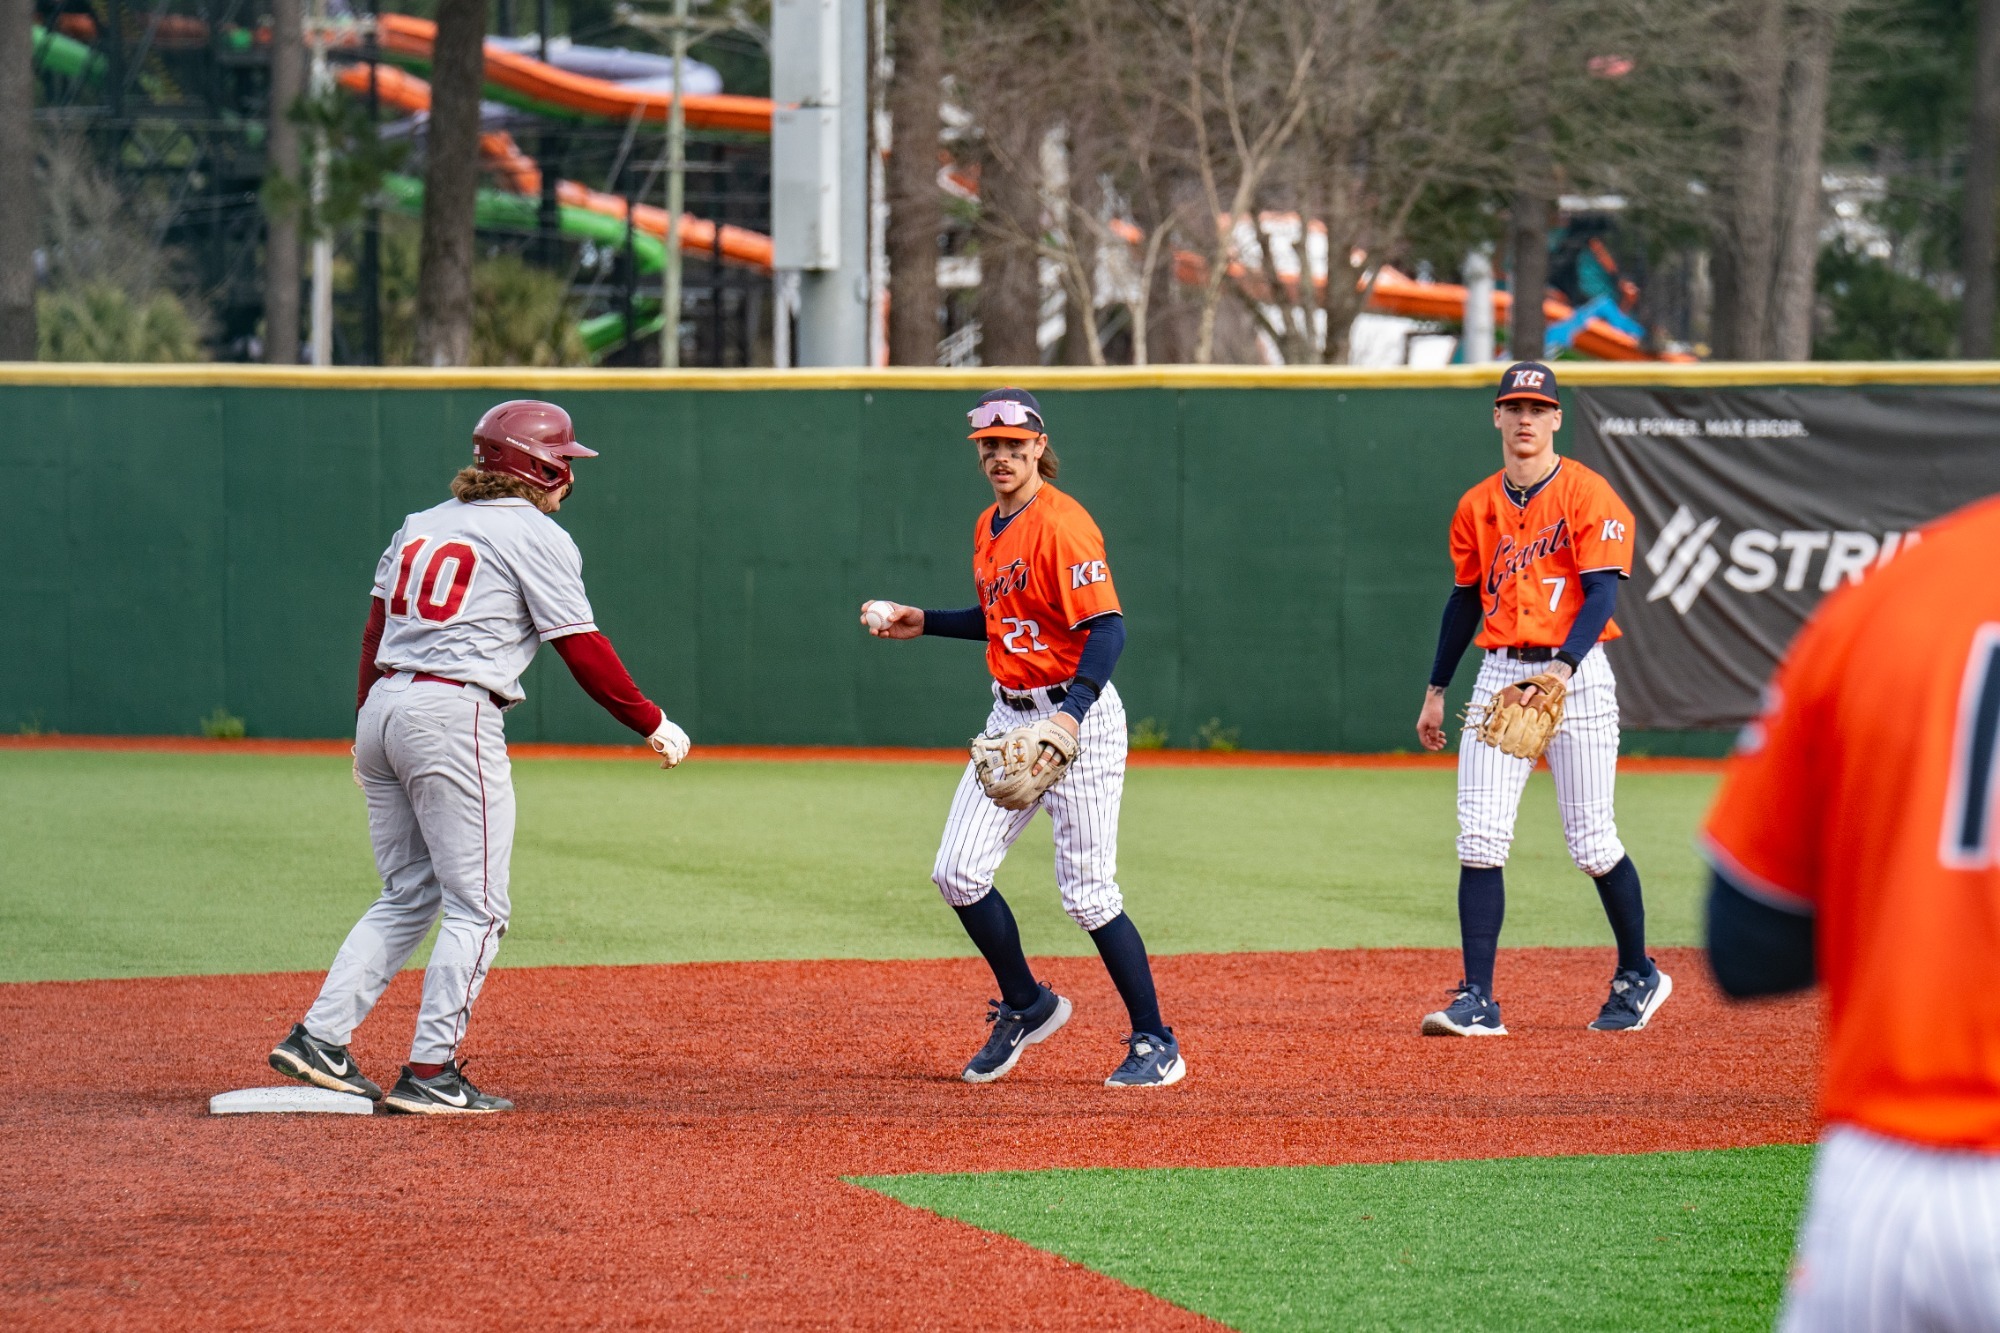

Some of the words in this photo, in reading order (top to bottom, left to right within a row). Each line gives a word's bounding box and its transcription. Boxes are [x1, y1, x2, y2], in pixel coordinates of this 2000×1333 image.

[1511, 370, 1546, 389] KC
[1705, 418, 1744, 437] MAX
[1066, 560, 1107, 590] KC
[1723, 529, 1922, 592] STRI
[389, 534, 481, 627] 10
[1541, 576, 1566, 613] 7
[1001, 617, 1049, 653] 22
